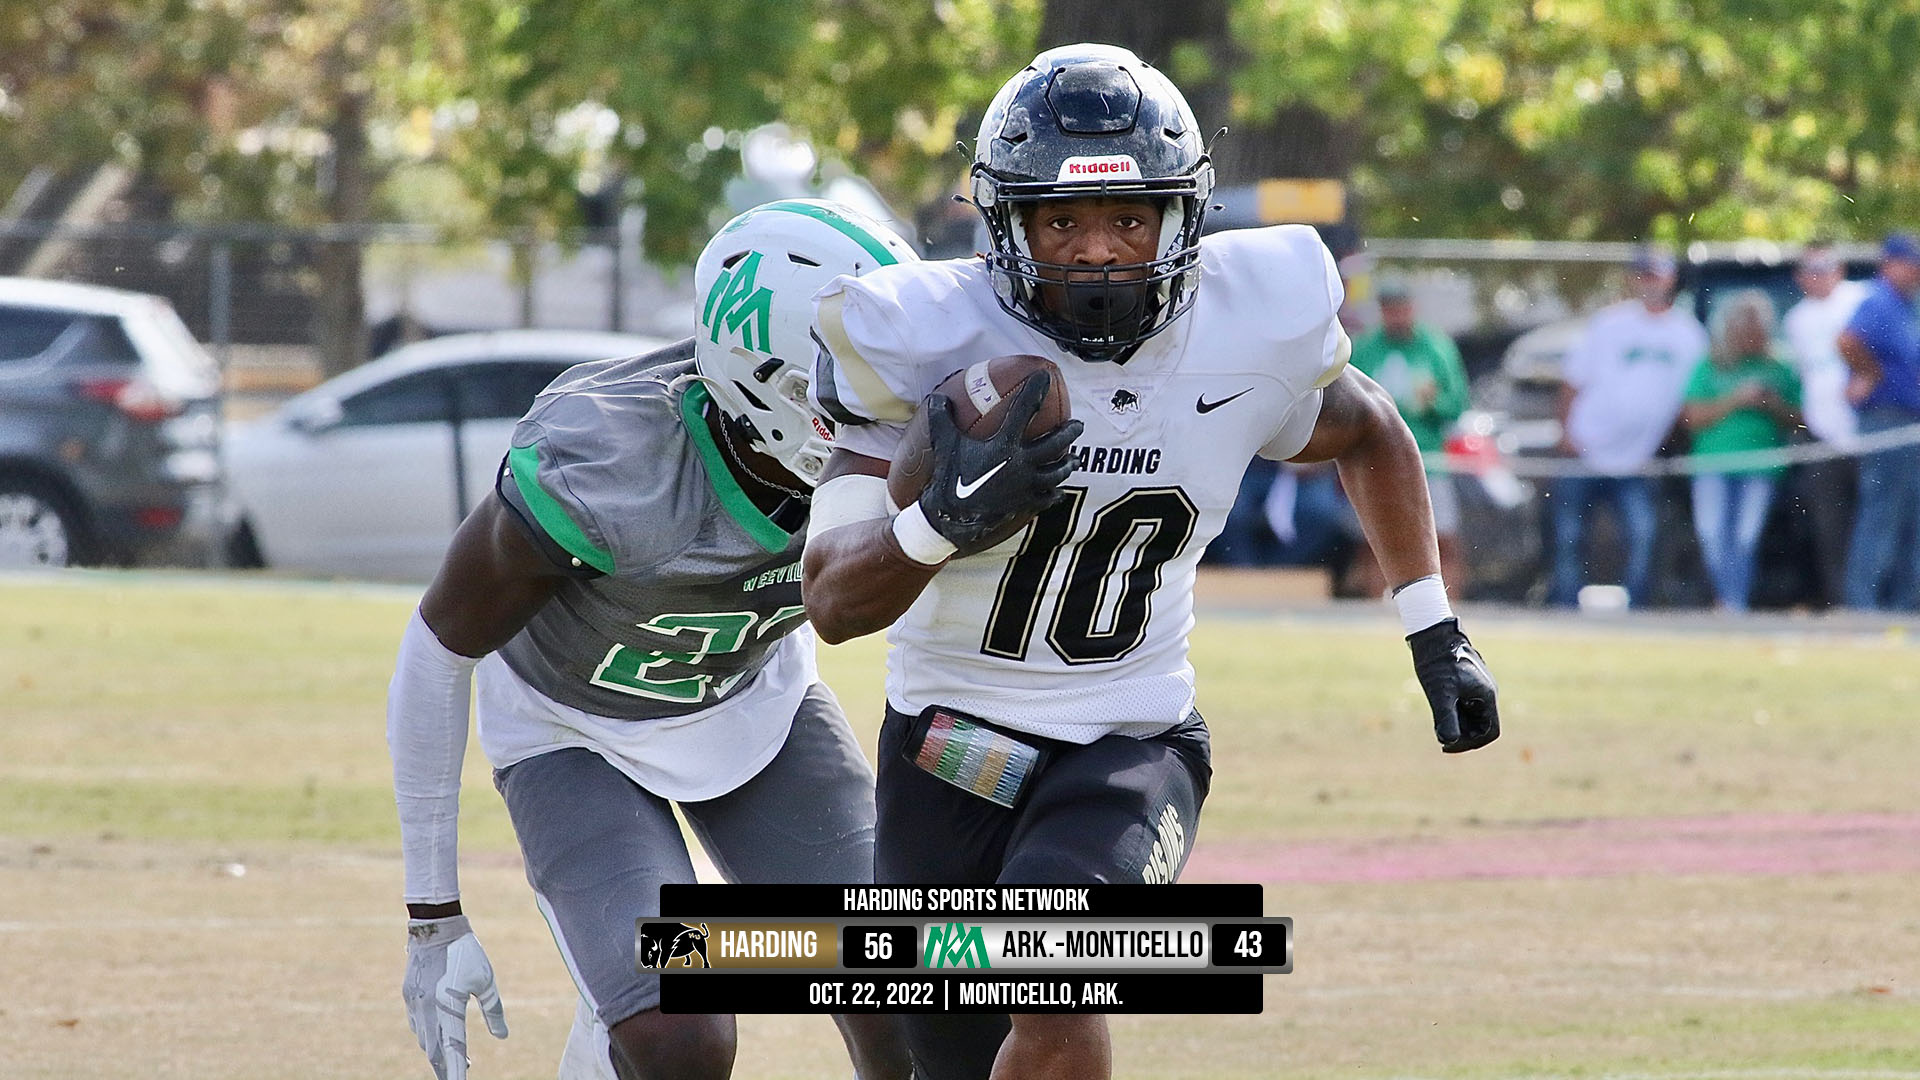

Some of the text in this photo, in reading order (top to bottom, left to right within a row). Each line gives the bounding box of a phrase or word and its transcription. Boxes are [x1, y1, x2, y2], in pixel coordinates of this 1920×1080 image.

[1069, 161, 1131, 174] Riddell
[811, 417, 836, 442] Ridd
[743, 561, 803, 592] WEEVIL
[980, 484, 1200, 667] 10
